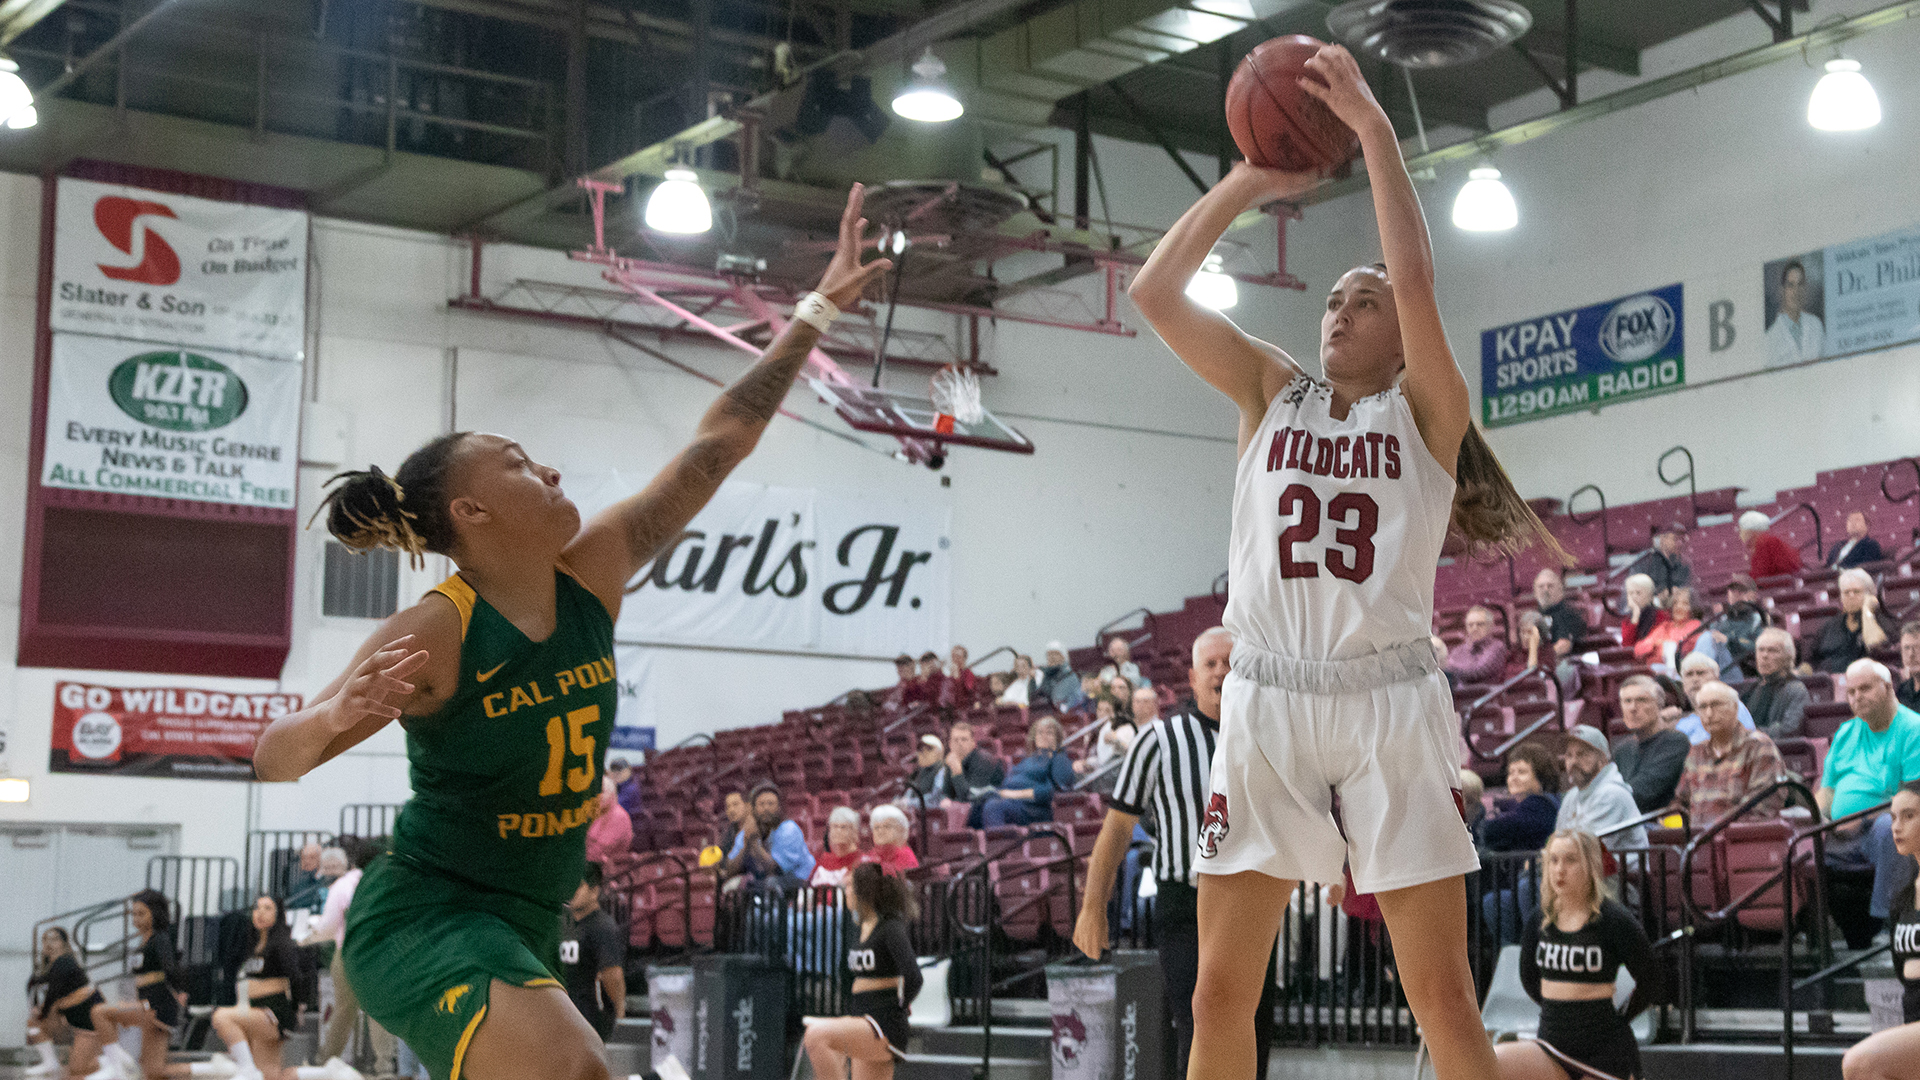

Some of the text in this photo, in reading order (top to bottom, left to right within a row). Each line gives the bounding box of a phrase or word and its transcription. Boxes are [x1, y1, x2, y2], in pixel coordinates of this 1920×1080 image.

[60, 281, 205, 317] Slater & Son
[1837, 269, 1868, 296] Dr.
[1496, 312, 1578, 361] KPAY
[1616, 305, 1657, 337] FOX
[1709, 298, 1737, 353] B
[132, 361, 228, 408] KZFR
[1497, 349, 1578, 388] SPORTS
[1598, 358, 1678, 398] RADIO
[66, 420, 282, 463] EVERY MUSIC GENRE
[1267, 426, 1402, 480] WILDCATS
[49, 462, 291, 504] ALL COMMERCIAL FREE
[102, 447, 245, 480] NEWS & TALK
[1278, 483, 1379, 585] 23
[624, 512, 932, 617] arl's Jr.
[60, 684, 301, 720] GO WILDCATS!
[483, 680, 554, 719] CAL
[539, 704, 601, 797] 15
[1536, 941, 1602, 973] CHICO
